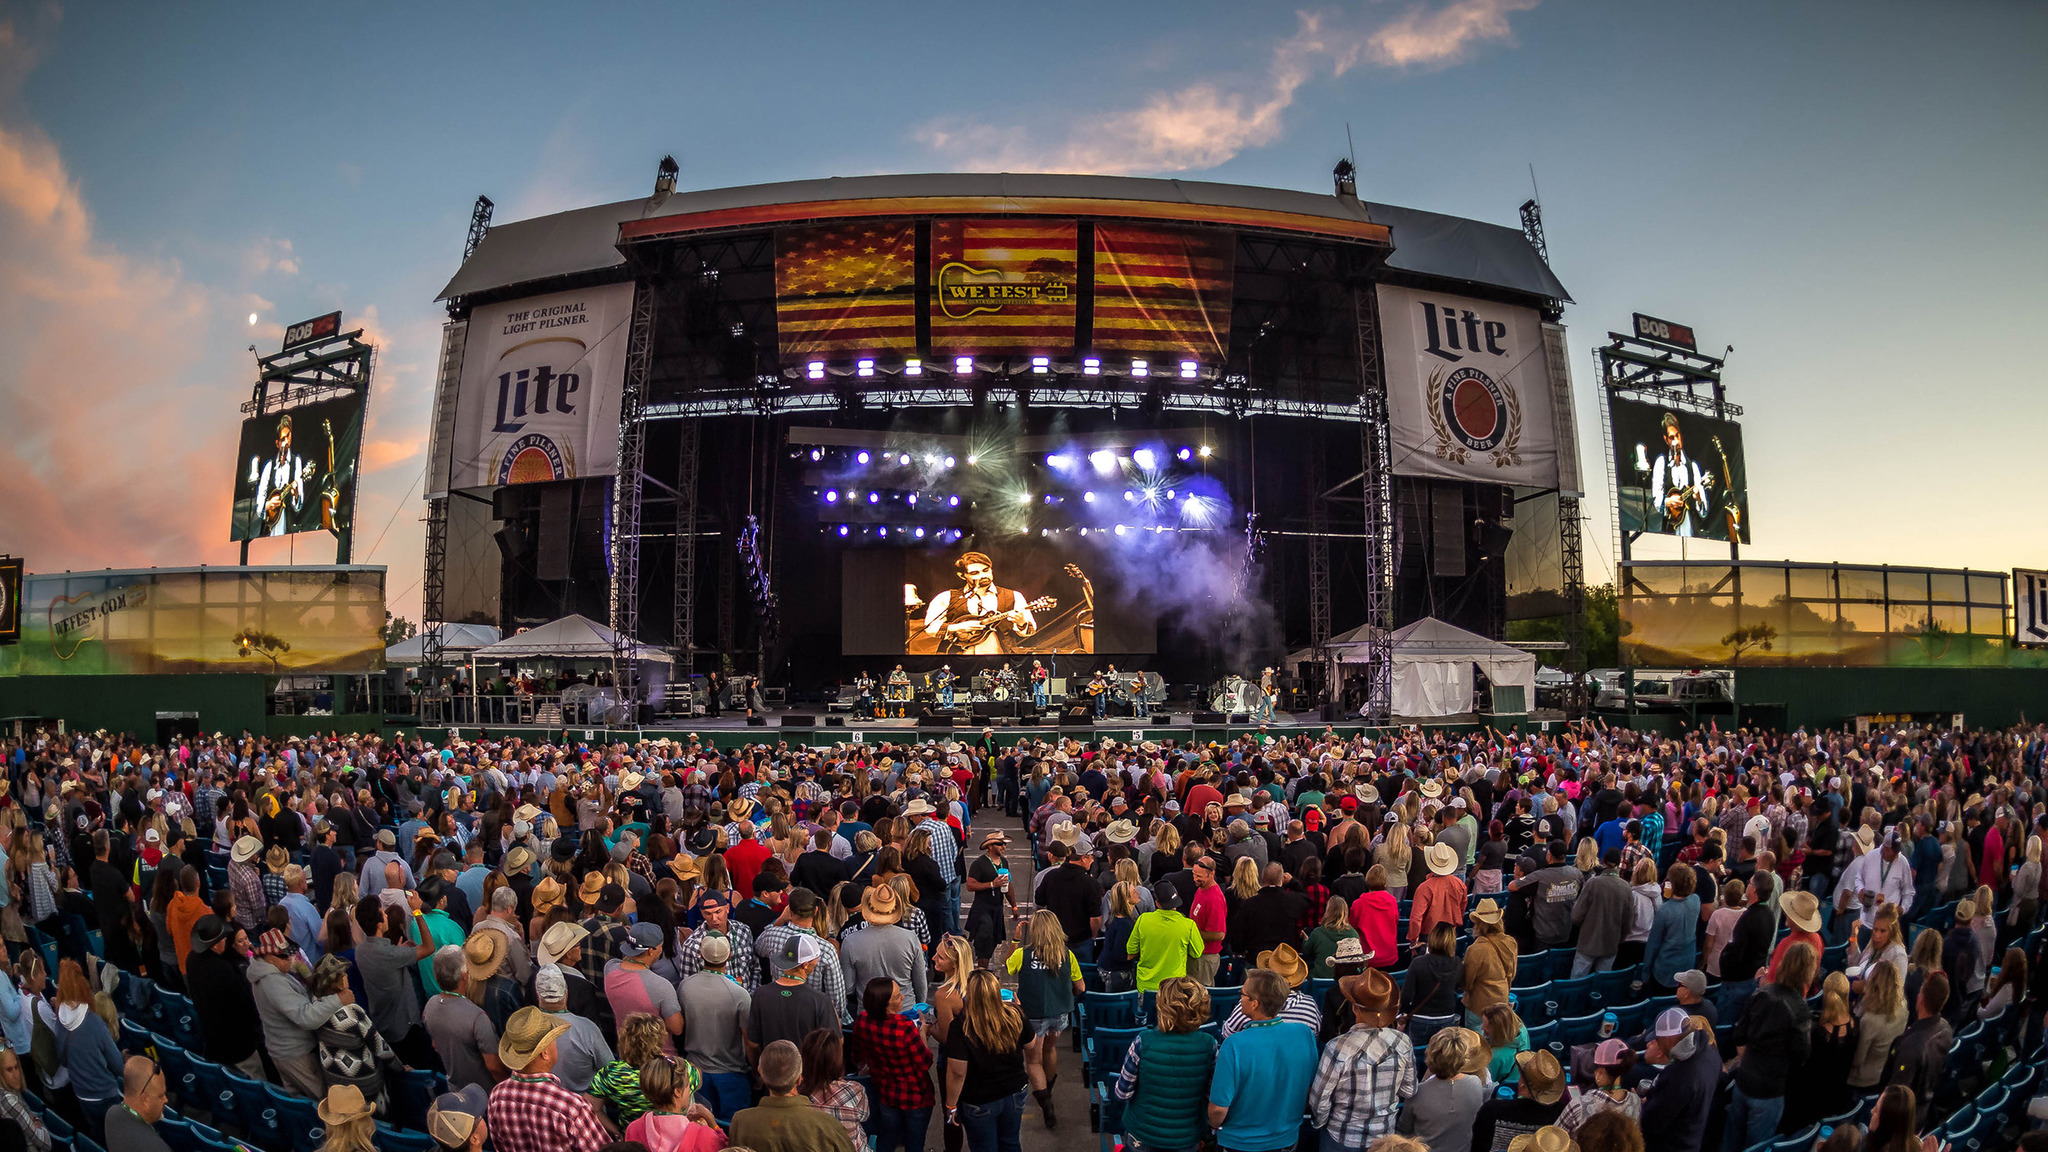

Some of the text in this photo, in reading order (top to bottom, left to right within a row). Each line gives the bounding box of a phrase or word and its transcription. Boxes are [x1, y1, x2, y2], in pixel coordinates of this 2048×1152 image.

[949, 286, 1041, 298] WE FEST
[507, 302, 587, 323] THE ORIGINAL
[286, 322, 314, 345] BOB
[503, 314, 589, 336] LIGHT PILSNER.
[1418, 301, 1507, 363] Lite
[1638, 317, 1670, 339] BOB
[1445, 369, 1503, 407] A FINE PILSNER
[491, 365, 580, 434] Lite
[1466, 438, 1494, 449] BEER
[500, 435, 563, 480] A FINE PILSNER
[54, 593, 127, 636] WEFEST.COM
[854, 732, 861, 742] 6
[840, 923, 859, 940] ROCK
